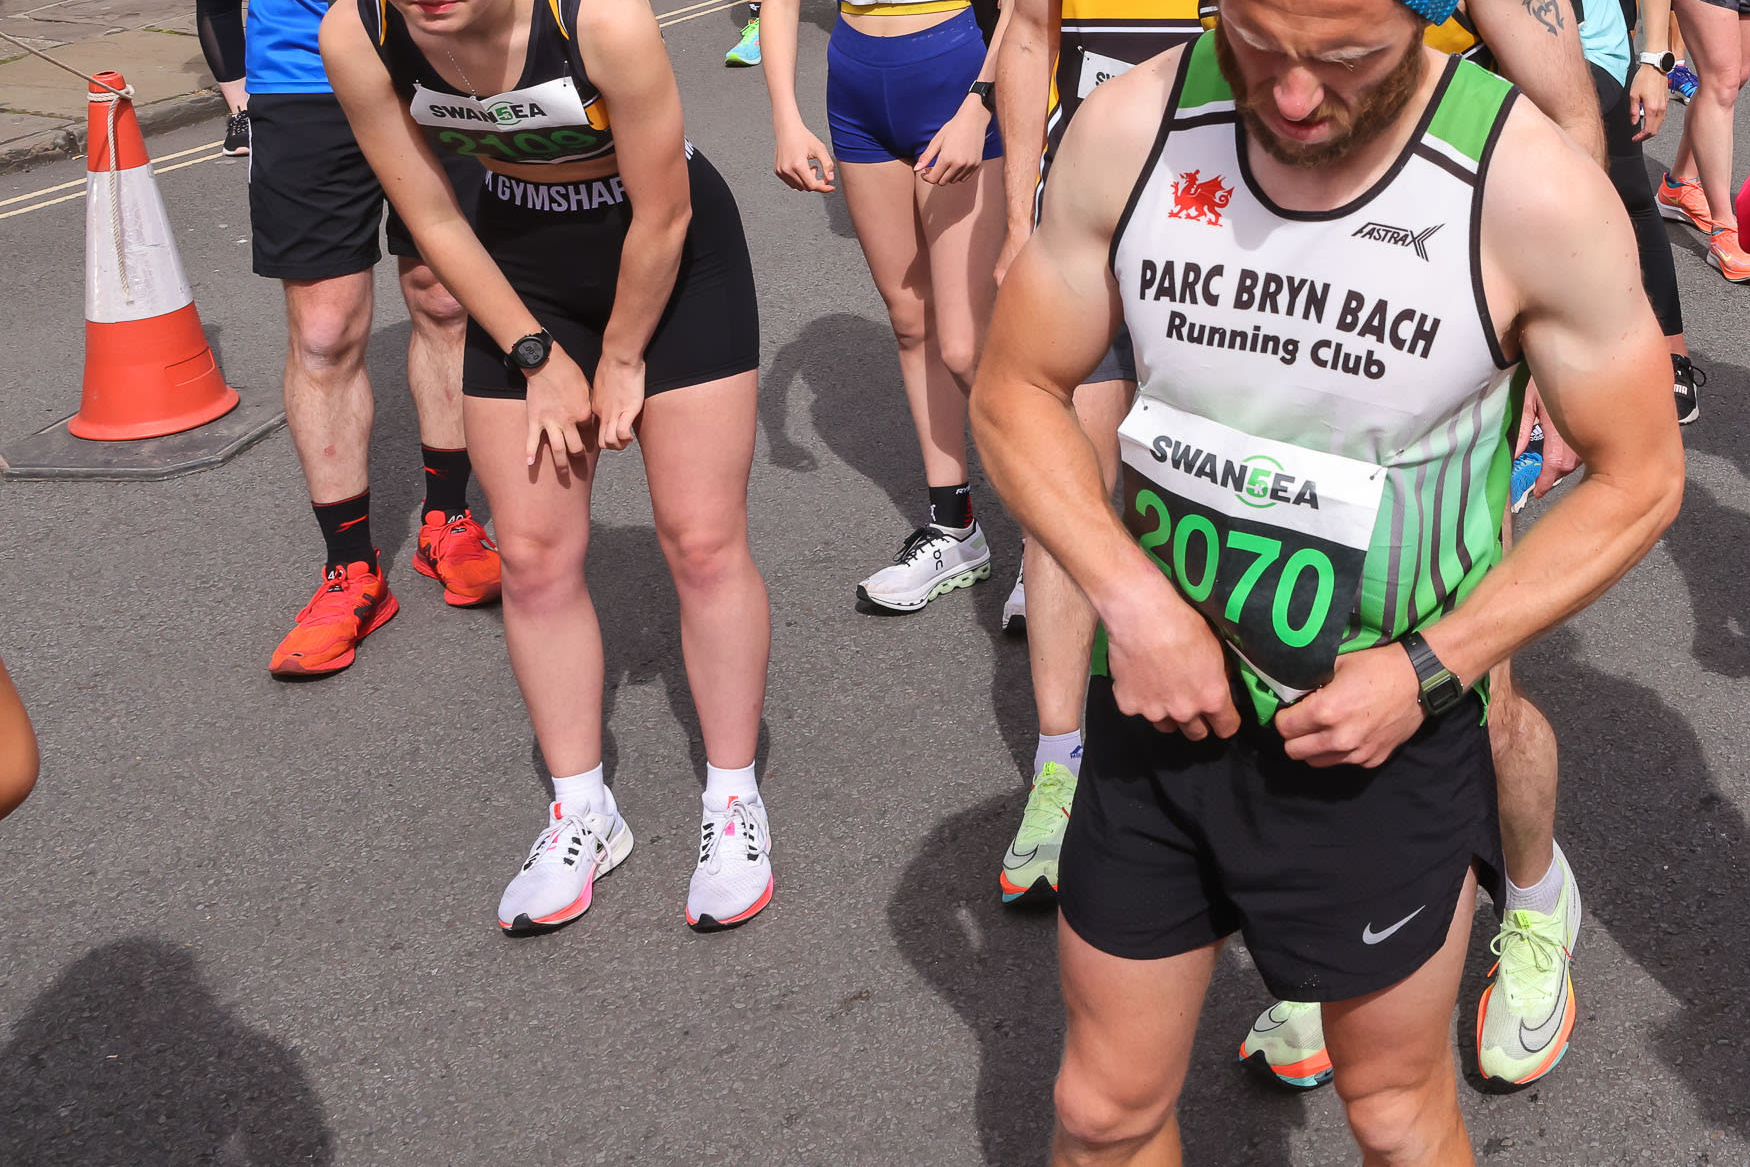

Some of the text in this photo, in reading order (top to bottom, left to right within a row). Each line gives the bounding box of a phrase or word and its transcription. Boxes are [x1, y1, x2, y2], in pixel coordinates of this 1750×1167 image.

[498, 175, 627, 213] GYMSHAR
[1139, 258, 1441, 359] PARC BRYN BACH
[1165, 310, 1386, 380] Running Club
[1135, 488, 1336, 649] 2070
